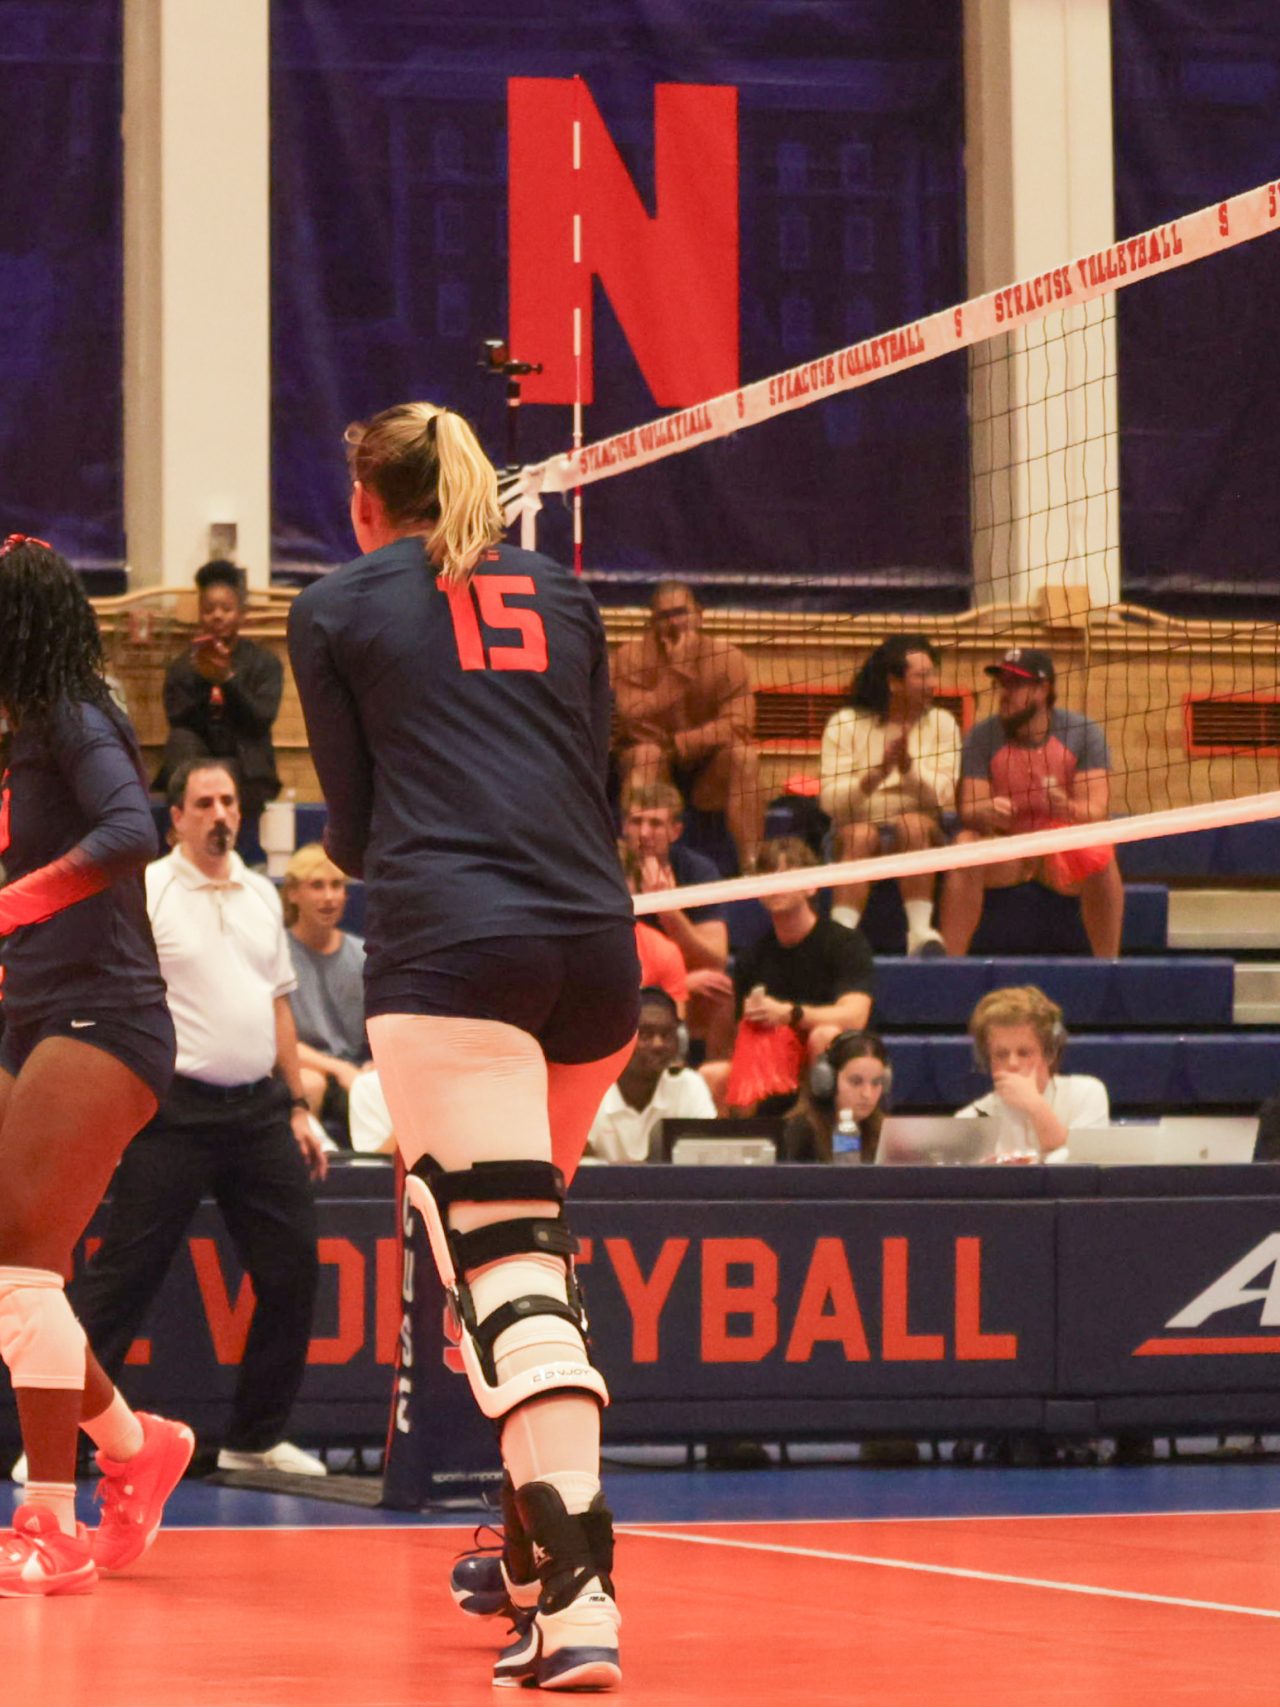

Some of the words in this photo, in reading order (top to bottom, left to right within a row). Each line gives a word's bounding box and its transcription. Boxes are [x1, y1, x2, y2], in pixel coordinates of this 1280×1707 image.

[507, 75, 740, 408] N
[434, 573, 550, 673] 15
[188, 1236, 1017, 1365] VOLYBALL
